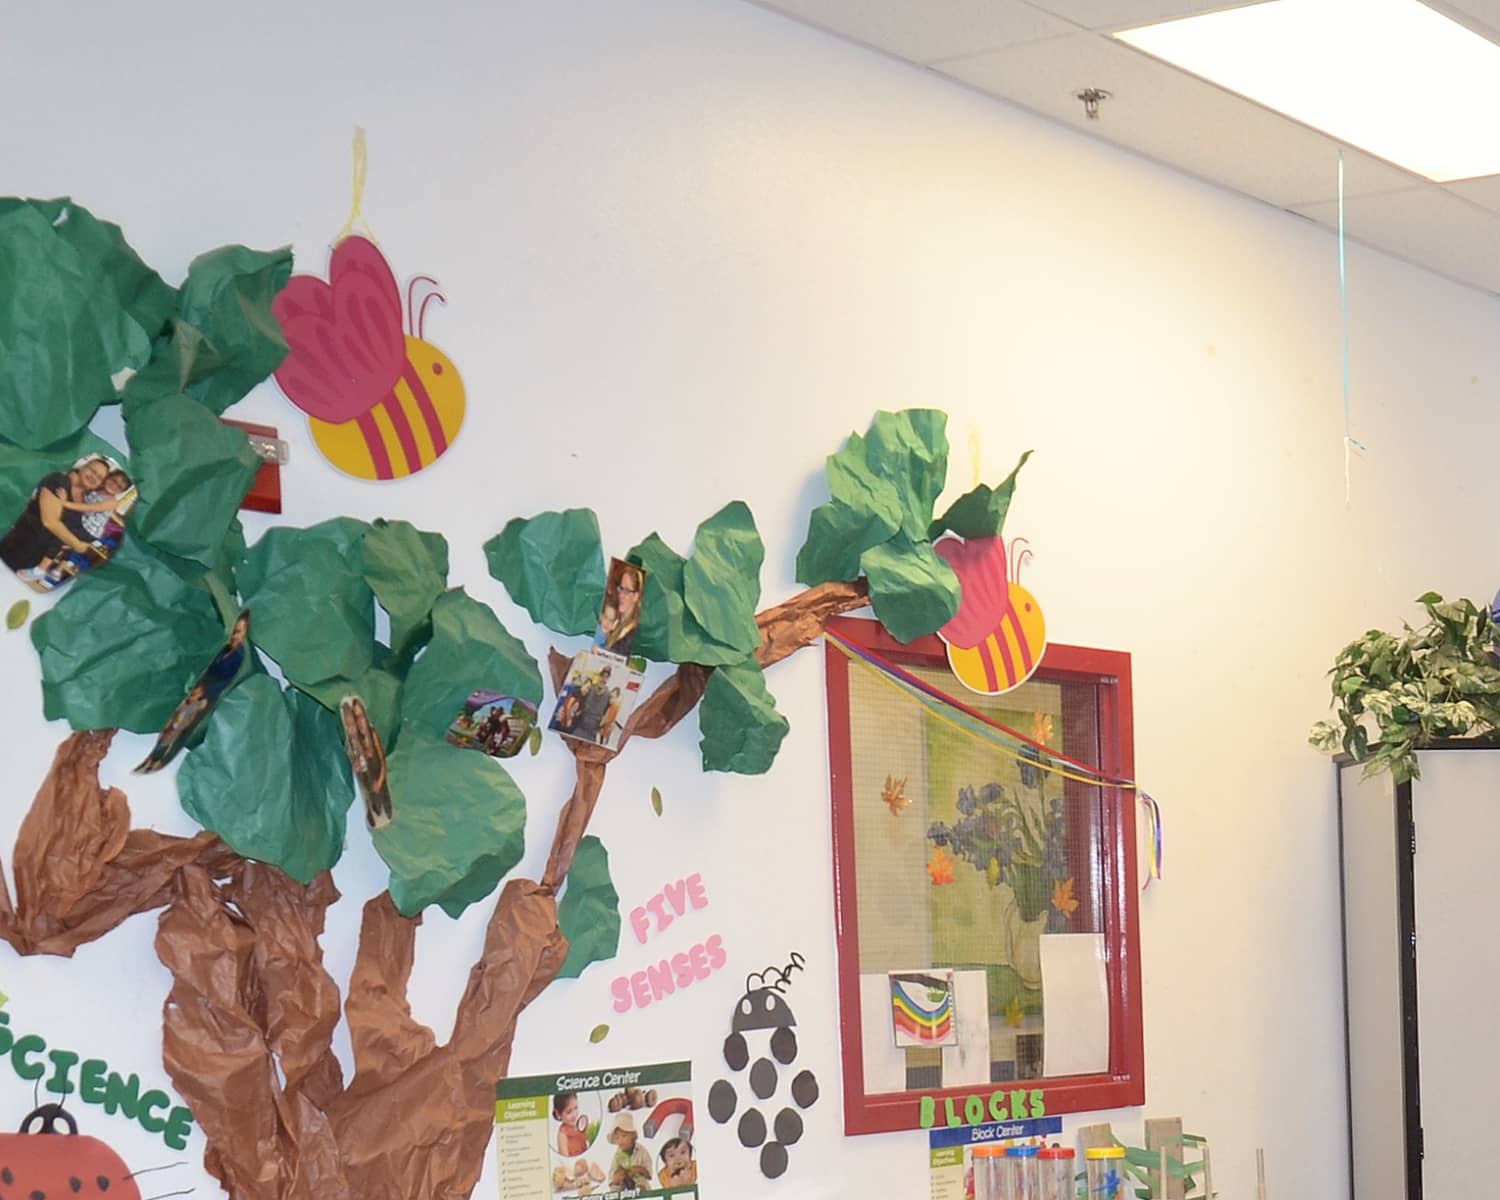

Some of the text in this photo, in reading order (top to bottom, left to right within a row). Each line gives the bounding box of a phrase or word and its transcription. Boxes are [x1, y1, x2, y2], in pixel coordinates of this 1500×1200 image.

[629, 872, 709, 945] FIVE
[610, 933, 728, 1014] SENSES
[556, 1072, 641, 1091] Science Center
[507, 1100, 537, 1110] Learning
[919, 1088, 1046, 1129] BLOCKS
[971, 1124, 1025, 1141] Block Center
[604, 1191, 619, 1200] can
[619, 1187, 641, 1200] play?
